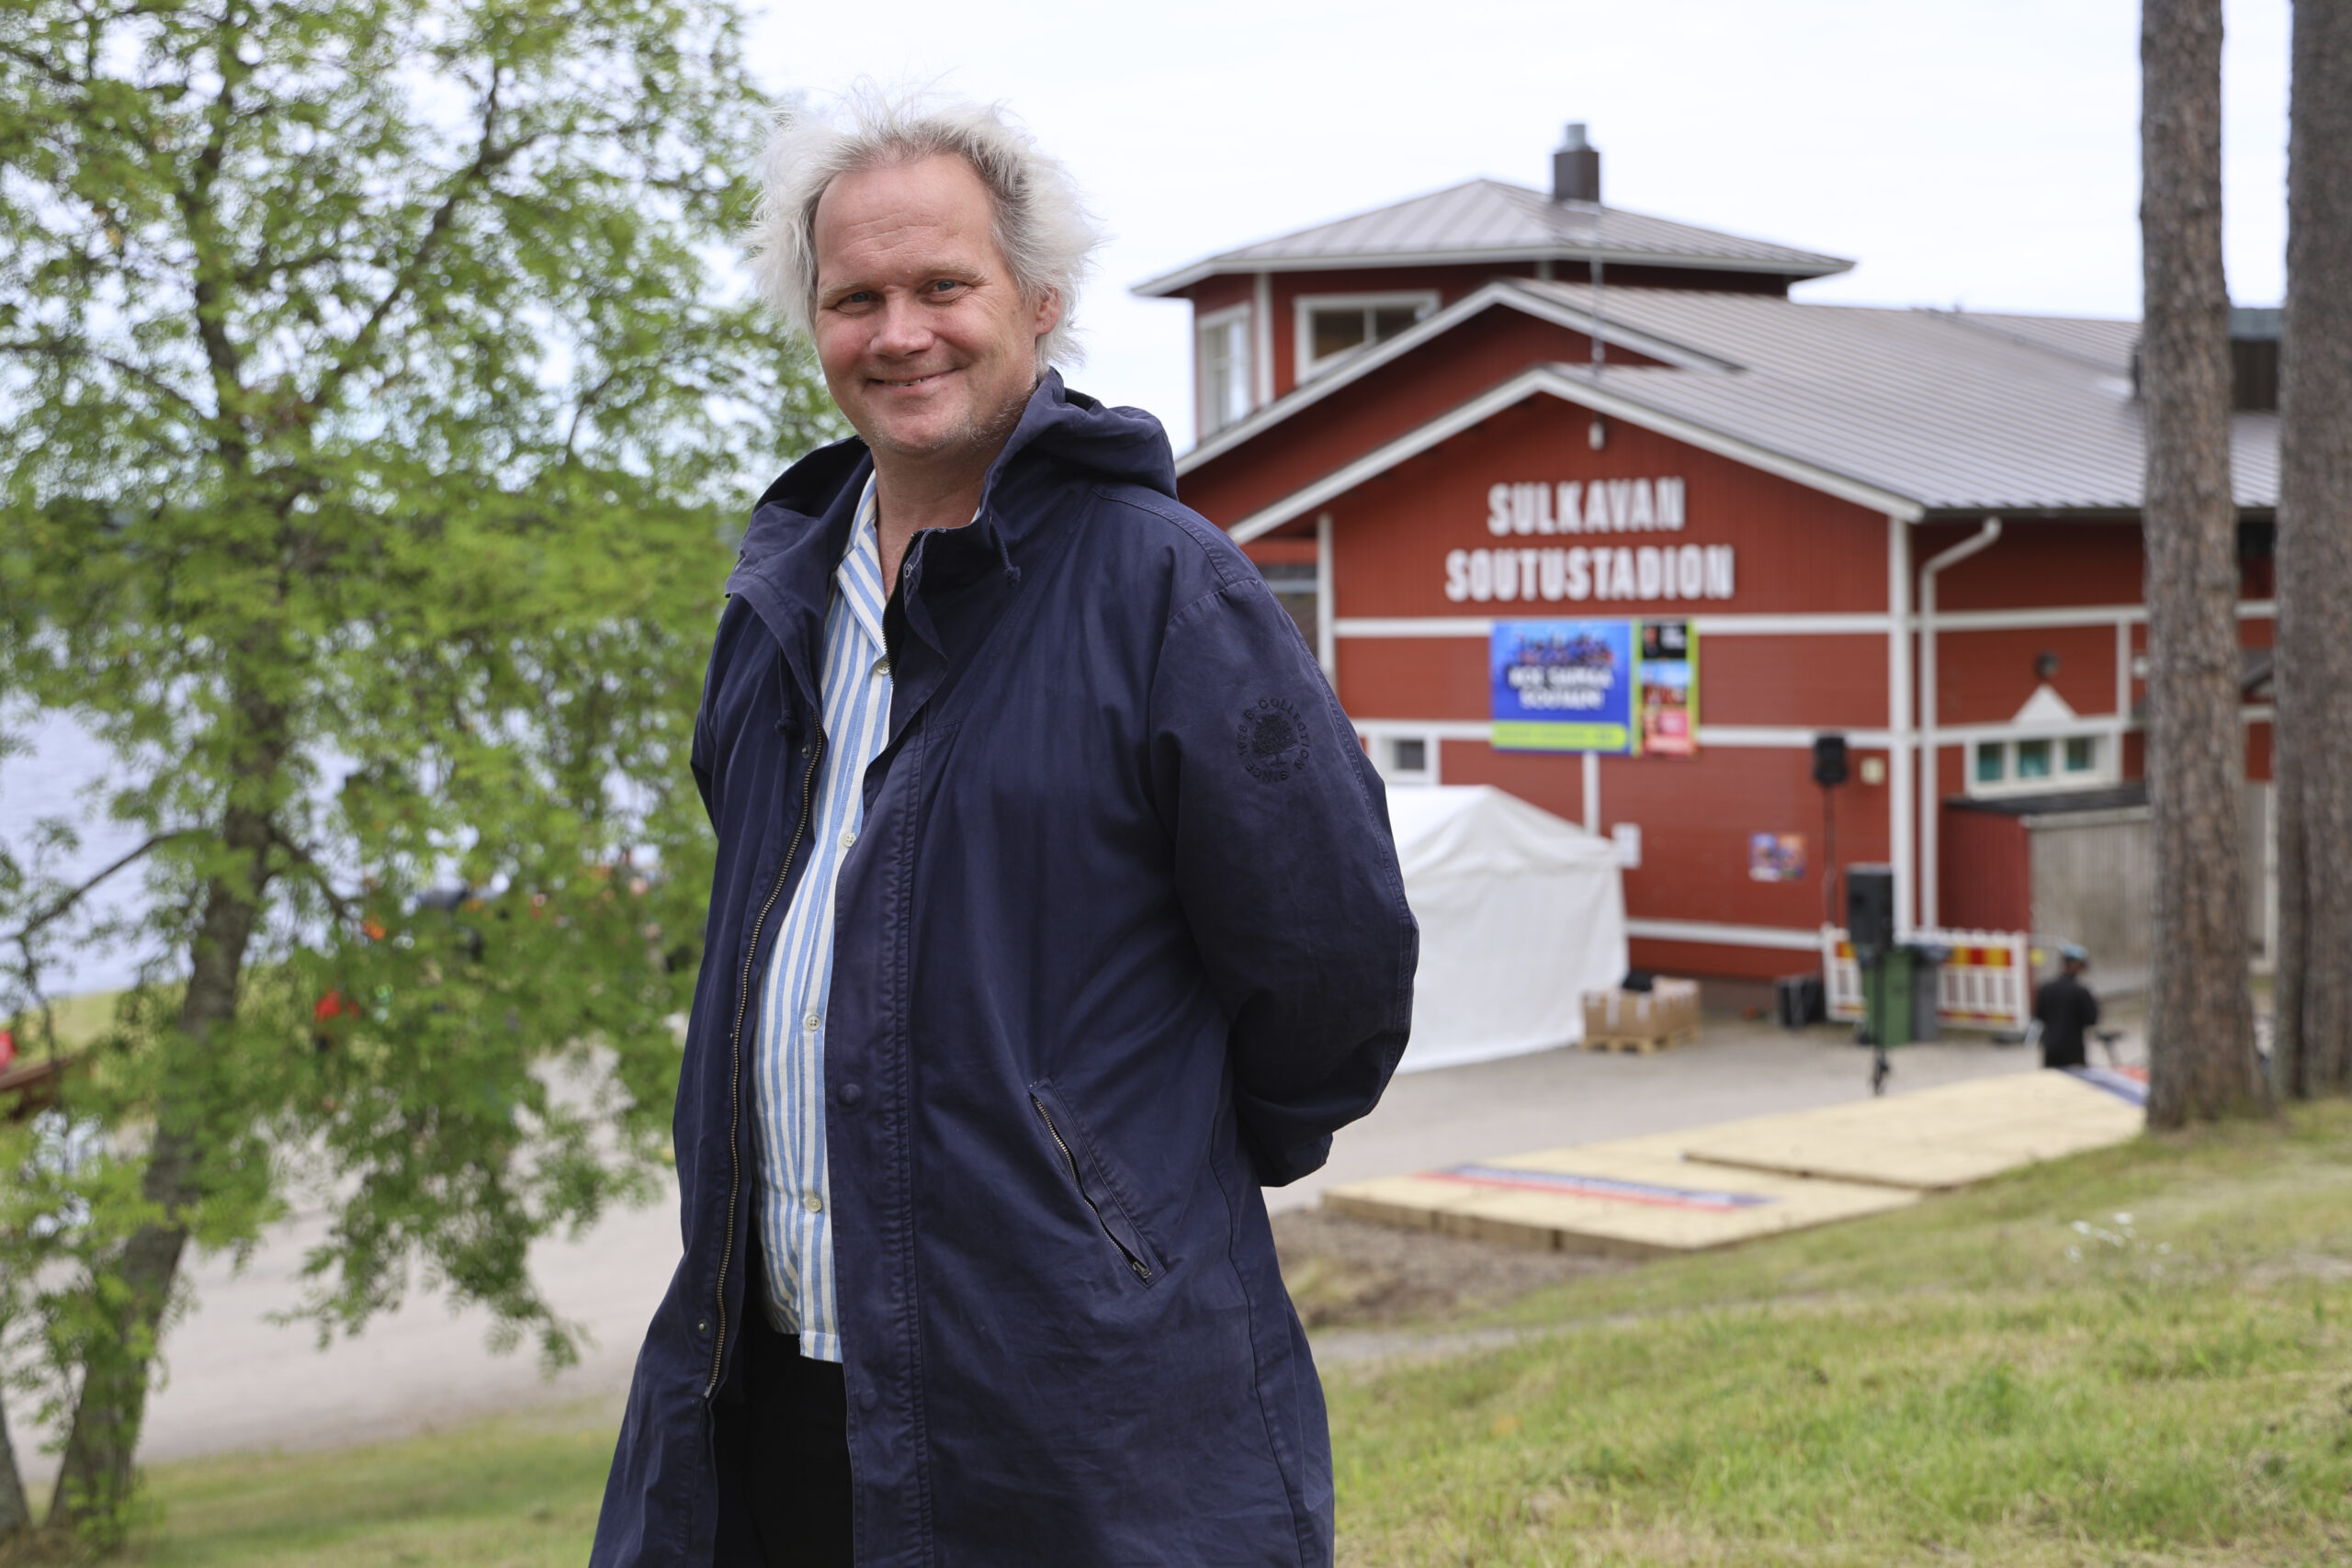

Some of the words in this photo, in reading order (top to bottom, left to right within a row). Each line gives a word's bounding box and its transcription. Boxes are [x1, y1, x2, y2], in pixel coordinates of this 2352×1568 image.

[1487, 477, 1685, 536] SULKAVAN
[1445, 544, 1735, 602] SOUTUSTADION
[1245, 762, 1288, 782] SINCE
